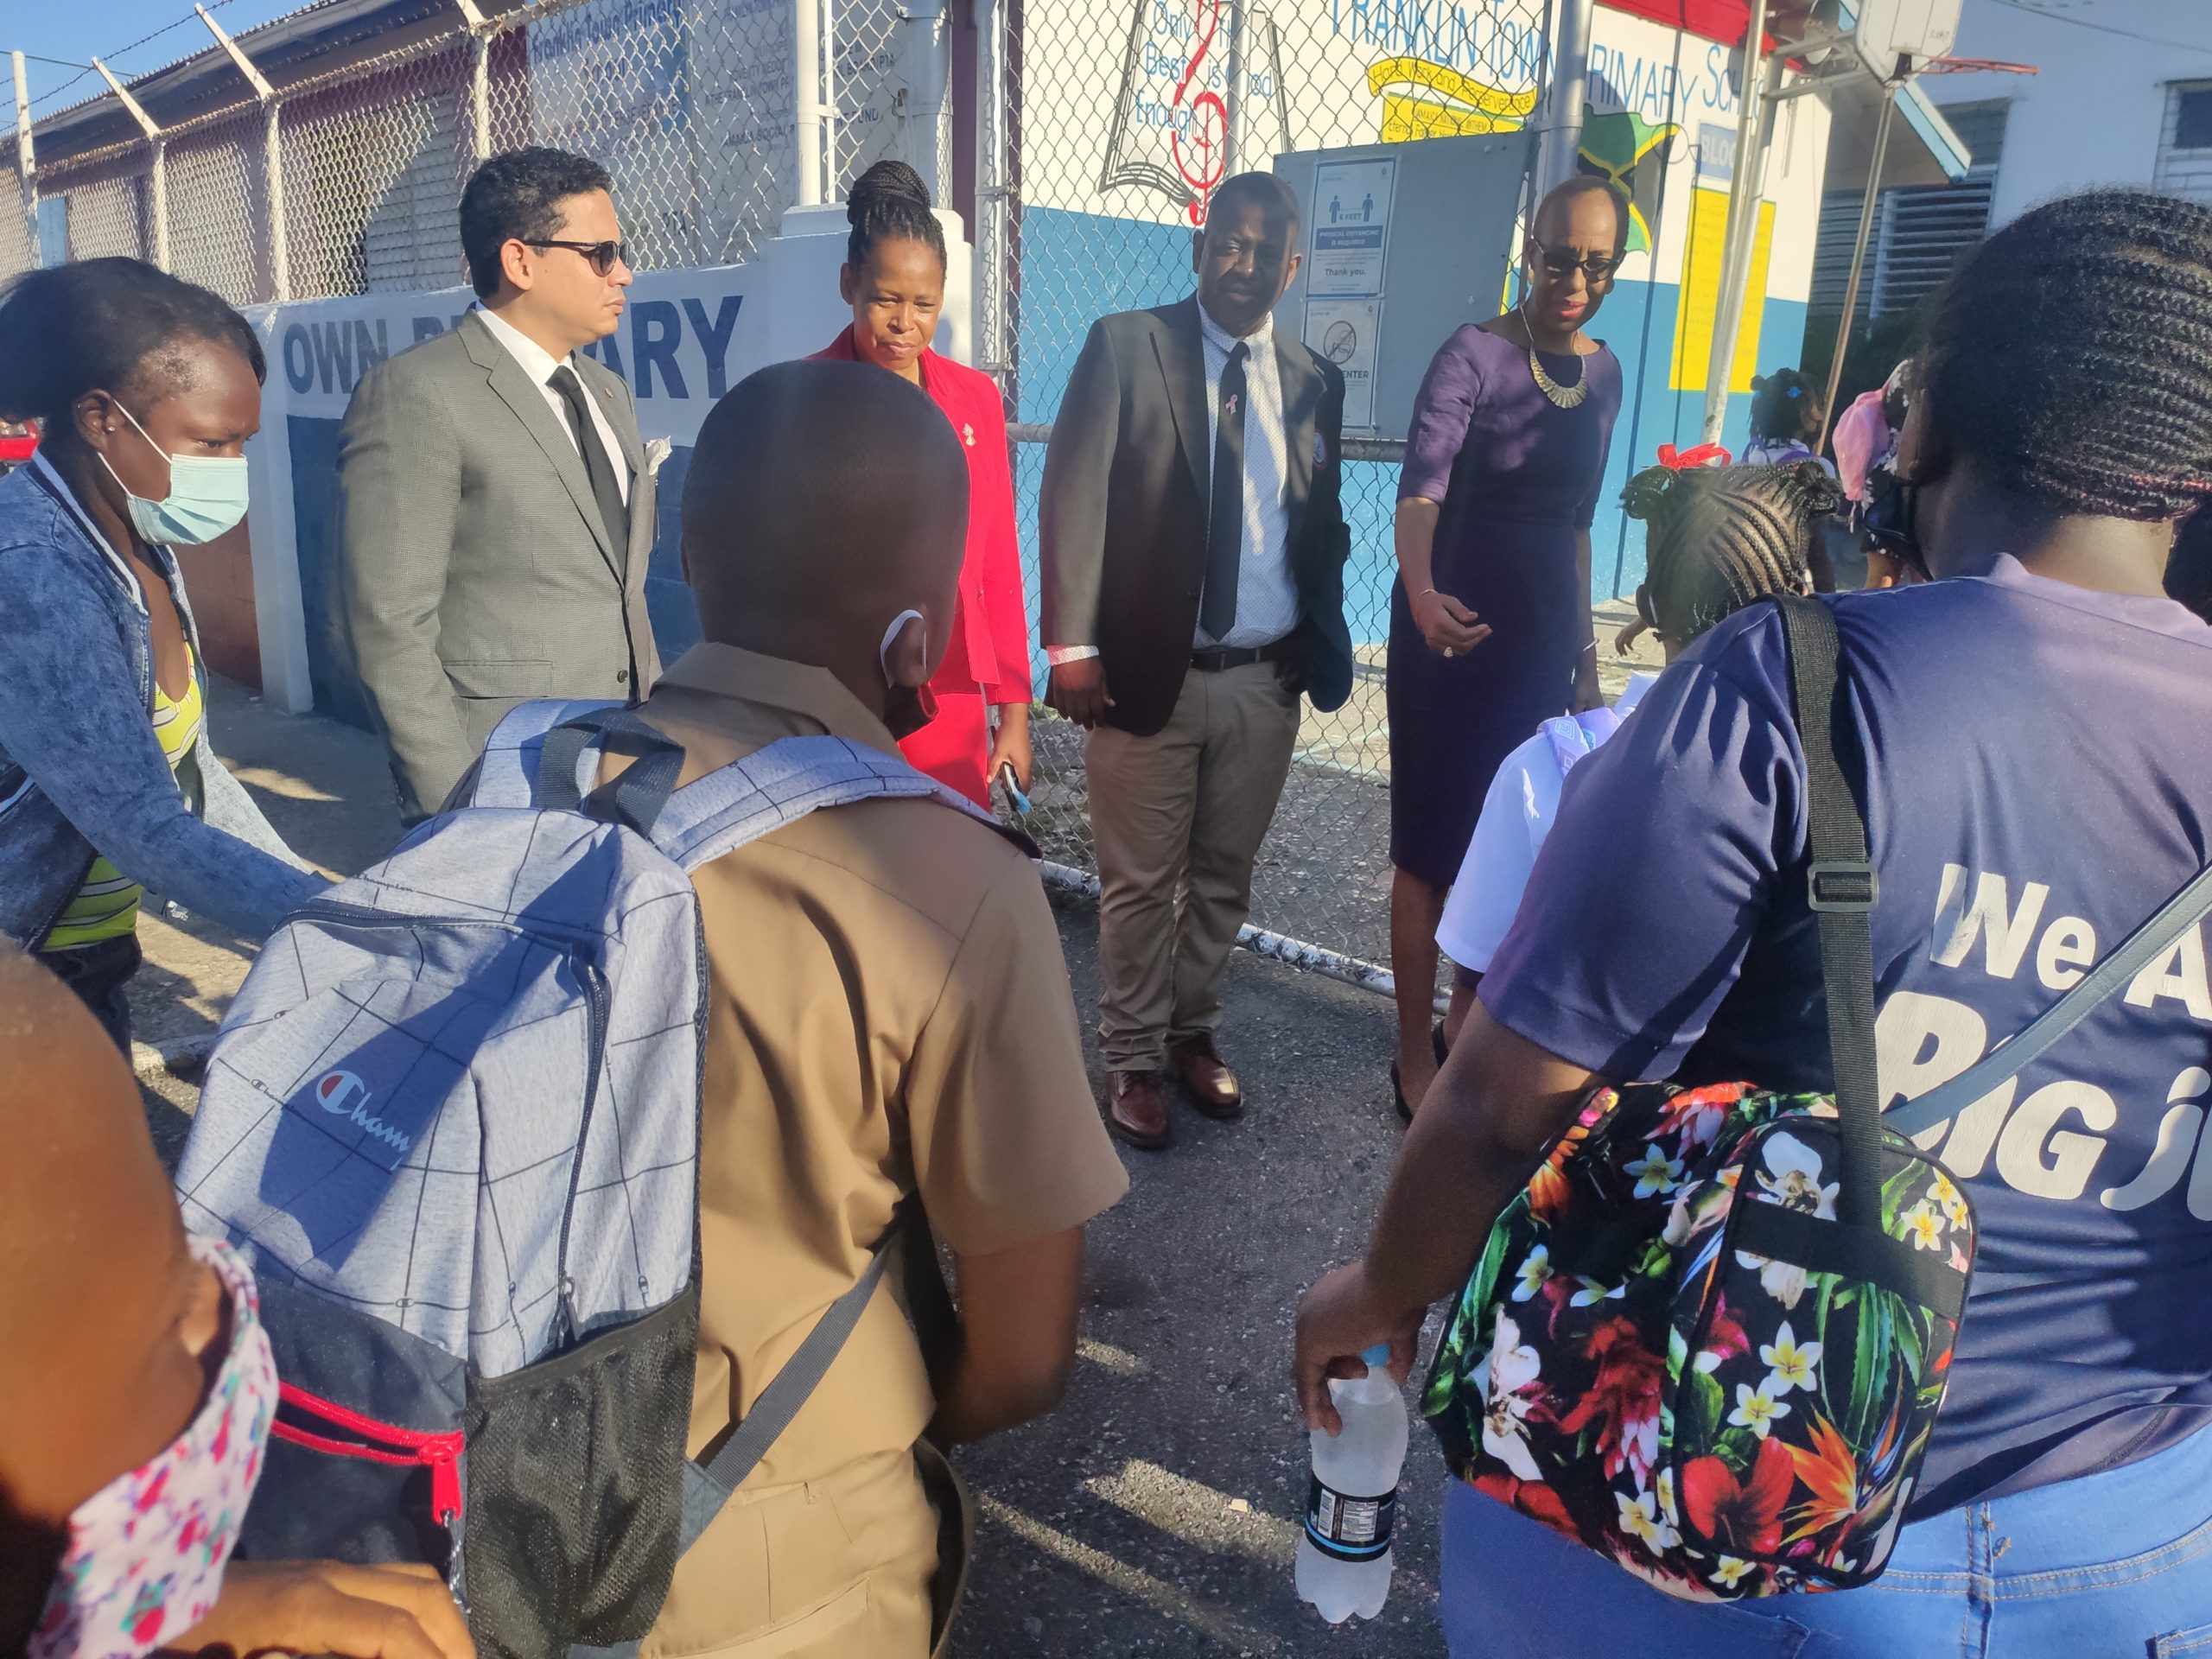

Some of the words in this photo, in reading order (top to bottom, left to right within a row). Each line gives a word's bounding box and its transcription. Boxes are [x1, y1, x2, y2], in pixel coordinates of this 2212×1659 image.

[1145, 41, 1187, 81] Best
[1372, 60, 1403, 81] Hard
[1436, 71, 1456, 92] and
[1325, 268, 1348, 276] Thank
[1930, 863, 2096, 990] We
